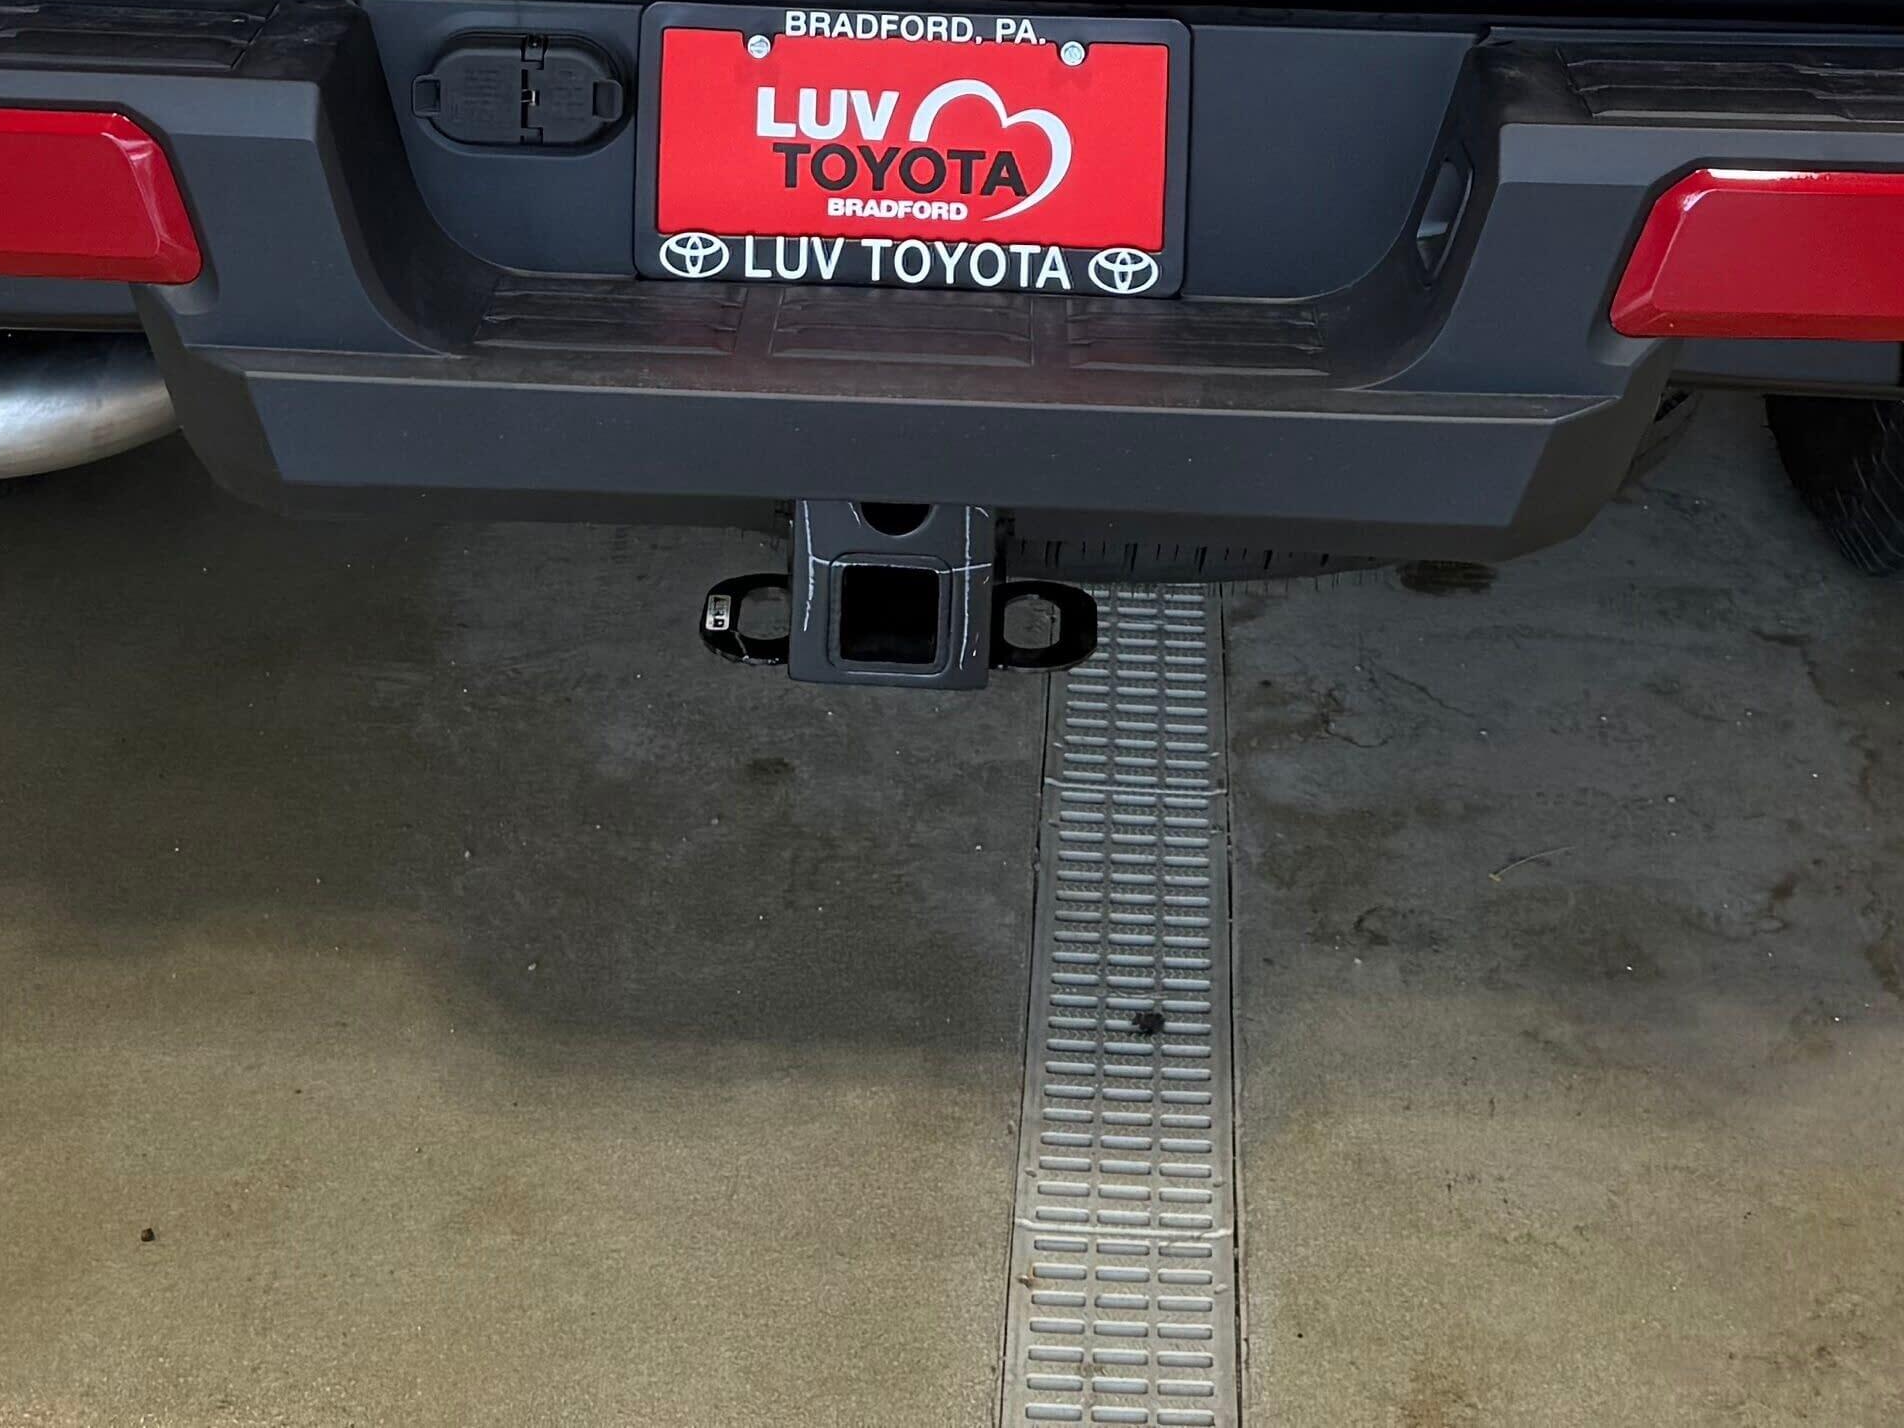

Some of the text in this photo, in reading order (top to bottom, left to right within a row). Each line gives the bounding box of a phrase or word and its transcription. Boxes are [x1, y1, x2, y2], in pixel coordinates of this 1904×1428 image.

[785, 10, 1046, 45] BRADFORD, PA.
[756, 86, 899, 142] LUV
[773, 143, 1028, 197] TOYOTA
[827, 198, 968, 221] BRADFORD
[744, 236, 1072, 291] LUV TOYOTA
